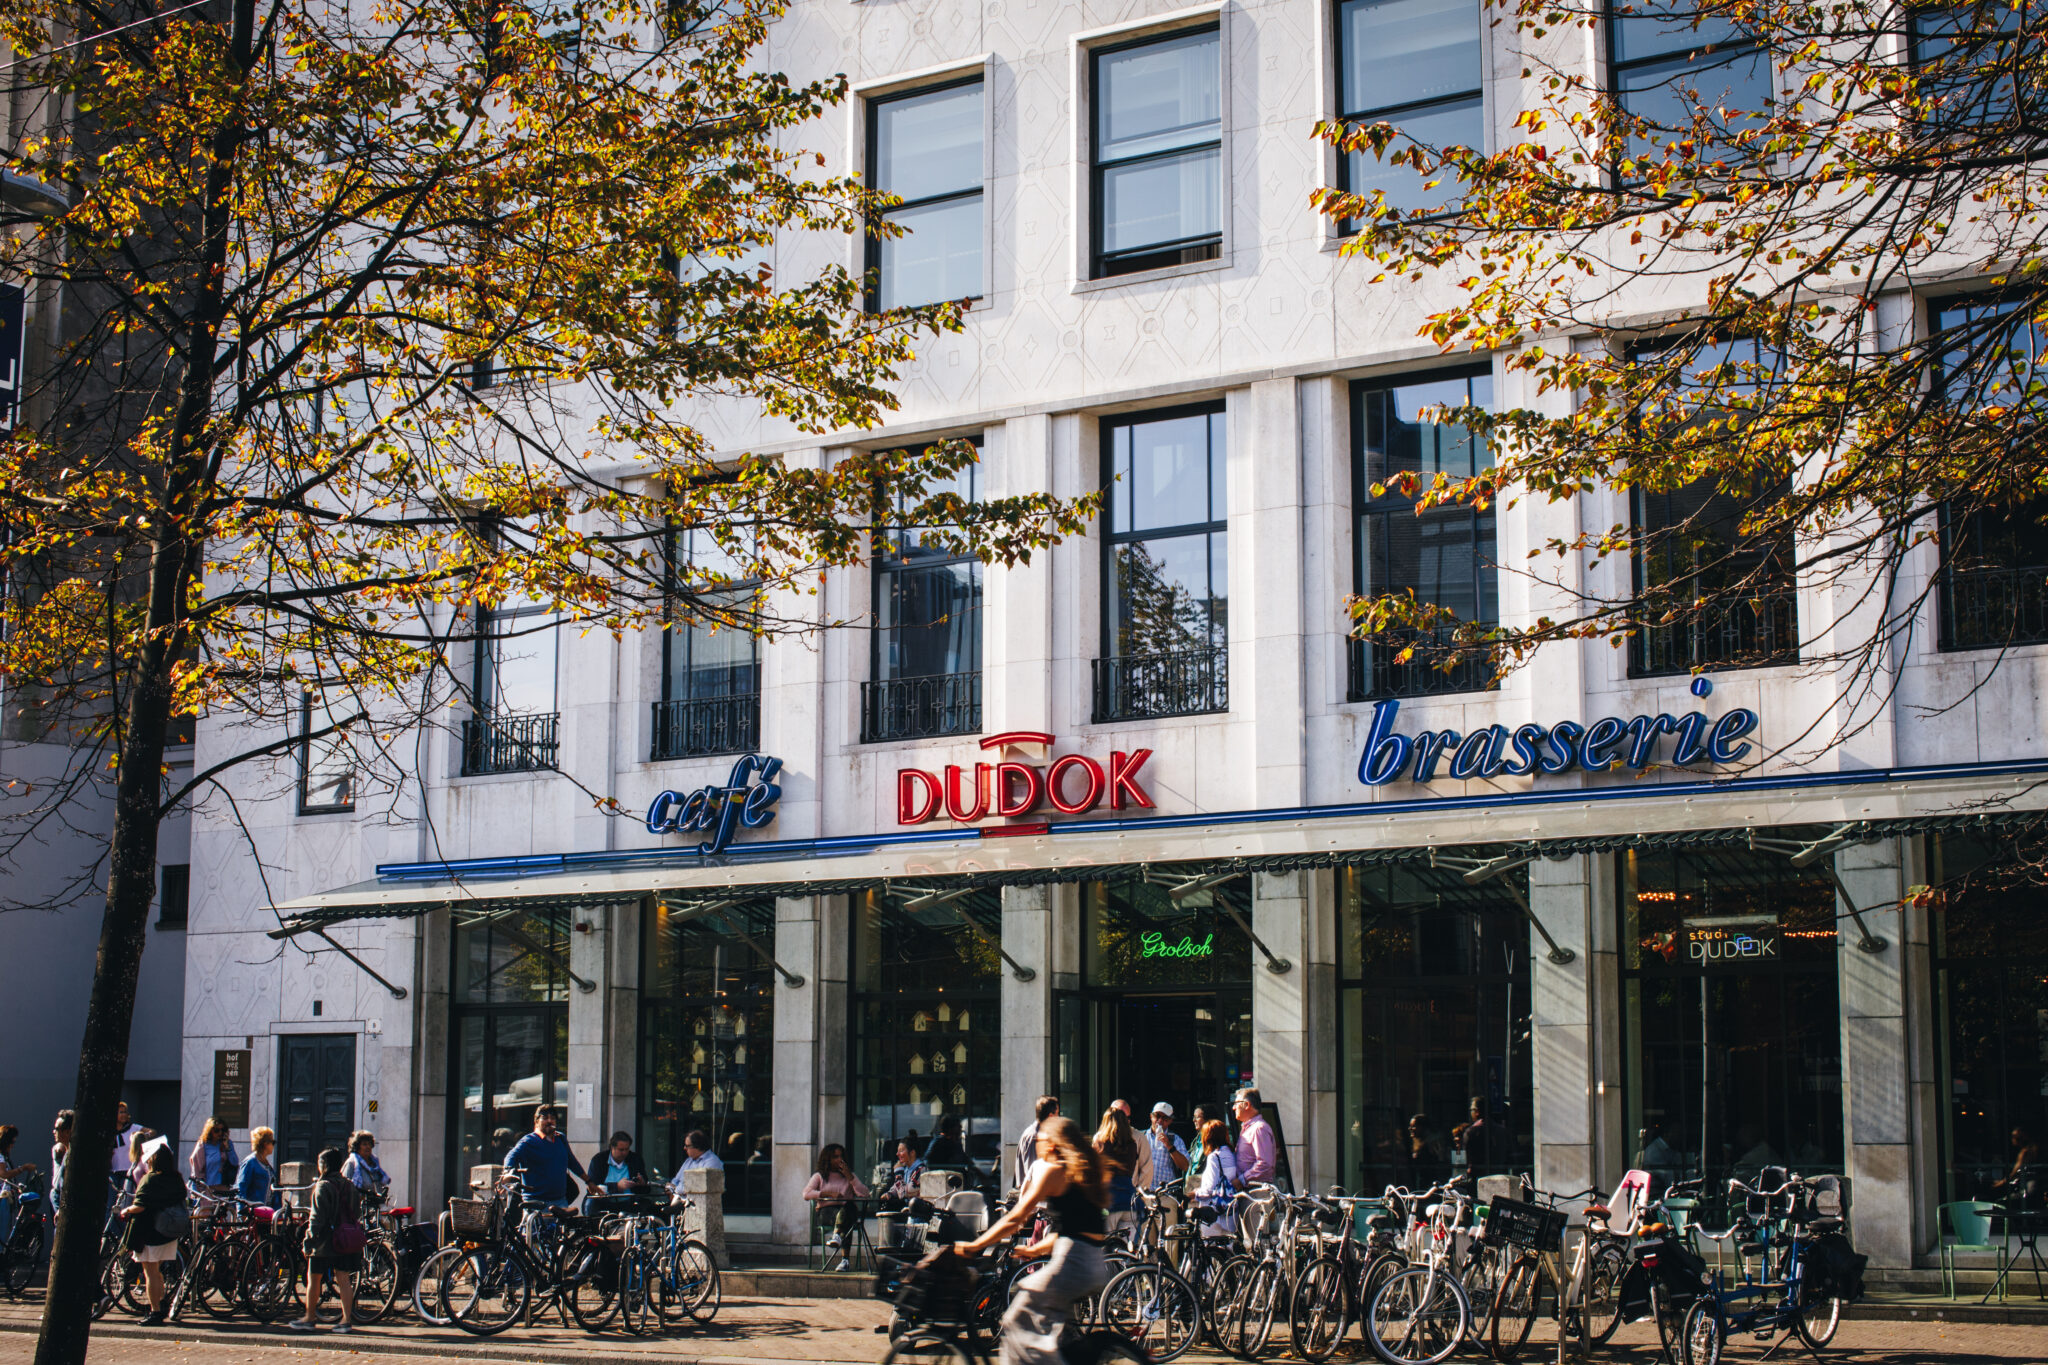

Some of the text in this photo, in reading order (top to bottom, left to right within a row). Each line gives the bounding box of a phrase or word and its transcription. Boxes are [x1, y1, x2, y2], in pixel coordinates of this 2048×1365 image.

[1358, 677, 1758, 786] brasserie
[646, 753, 784, 856] café
[898, 748, 1157, 826] DUDOK
[1141, 932, 1213, 958] Grolsch
[1690, 938, 1775, 959] DUDOK
[226, 1052, 239, 1061] hof
